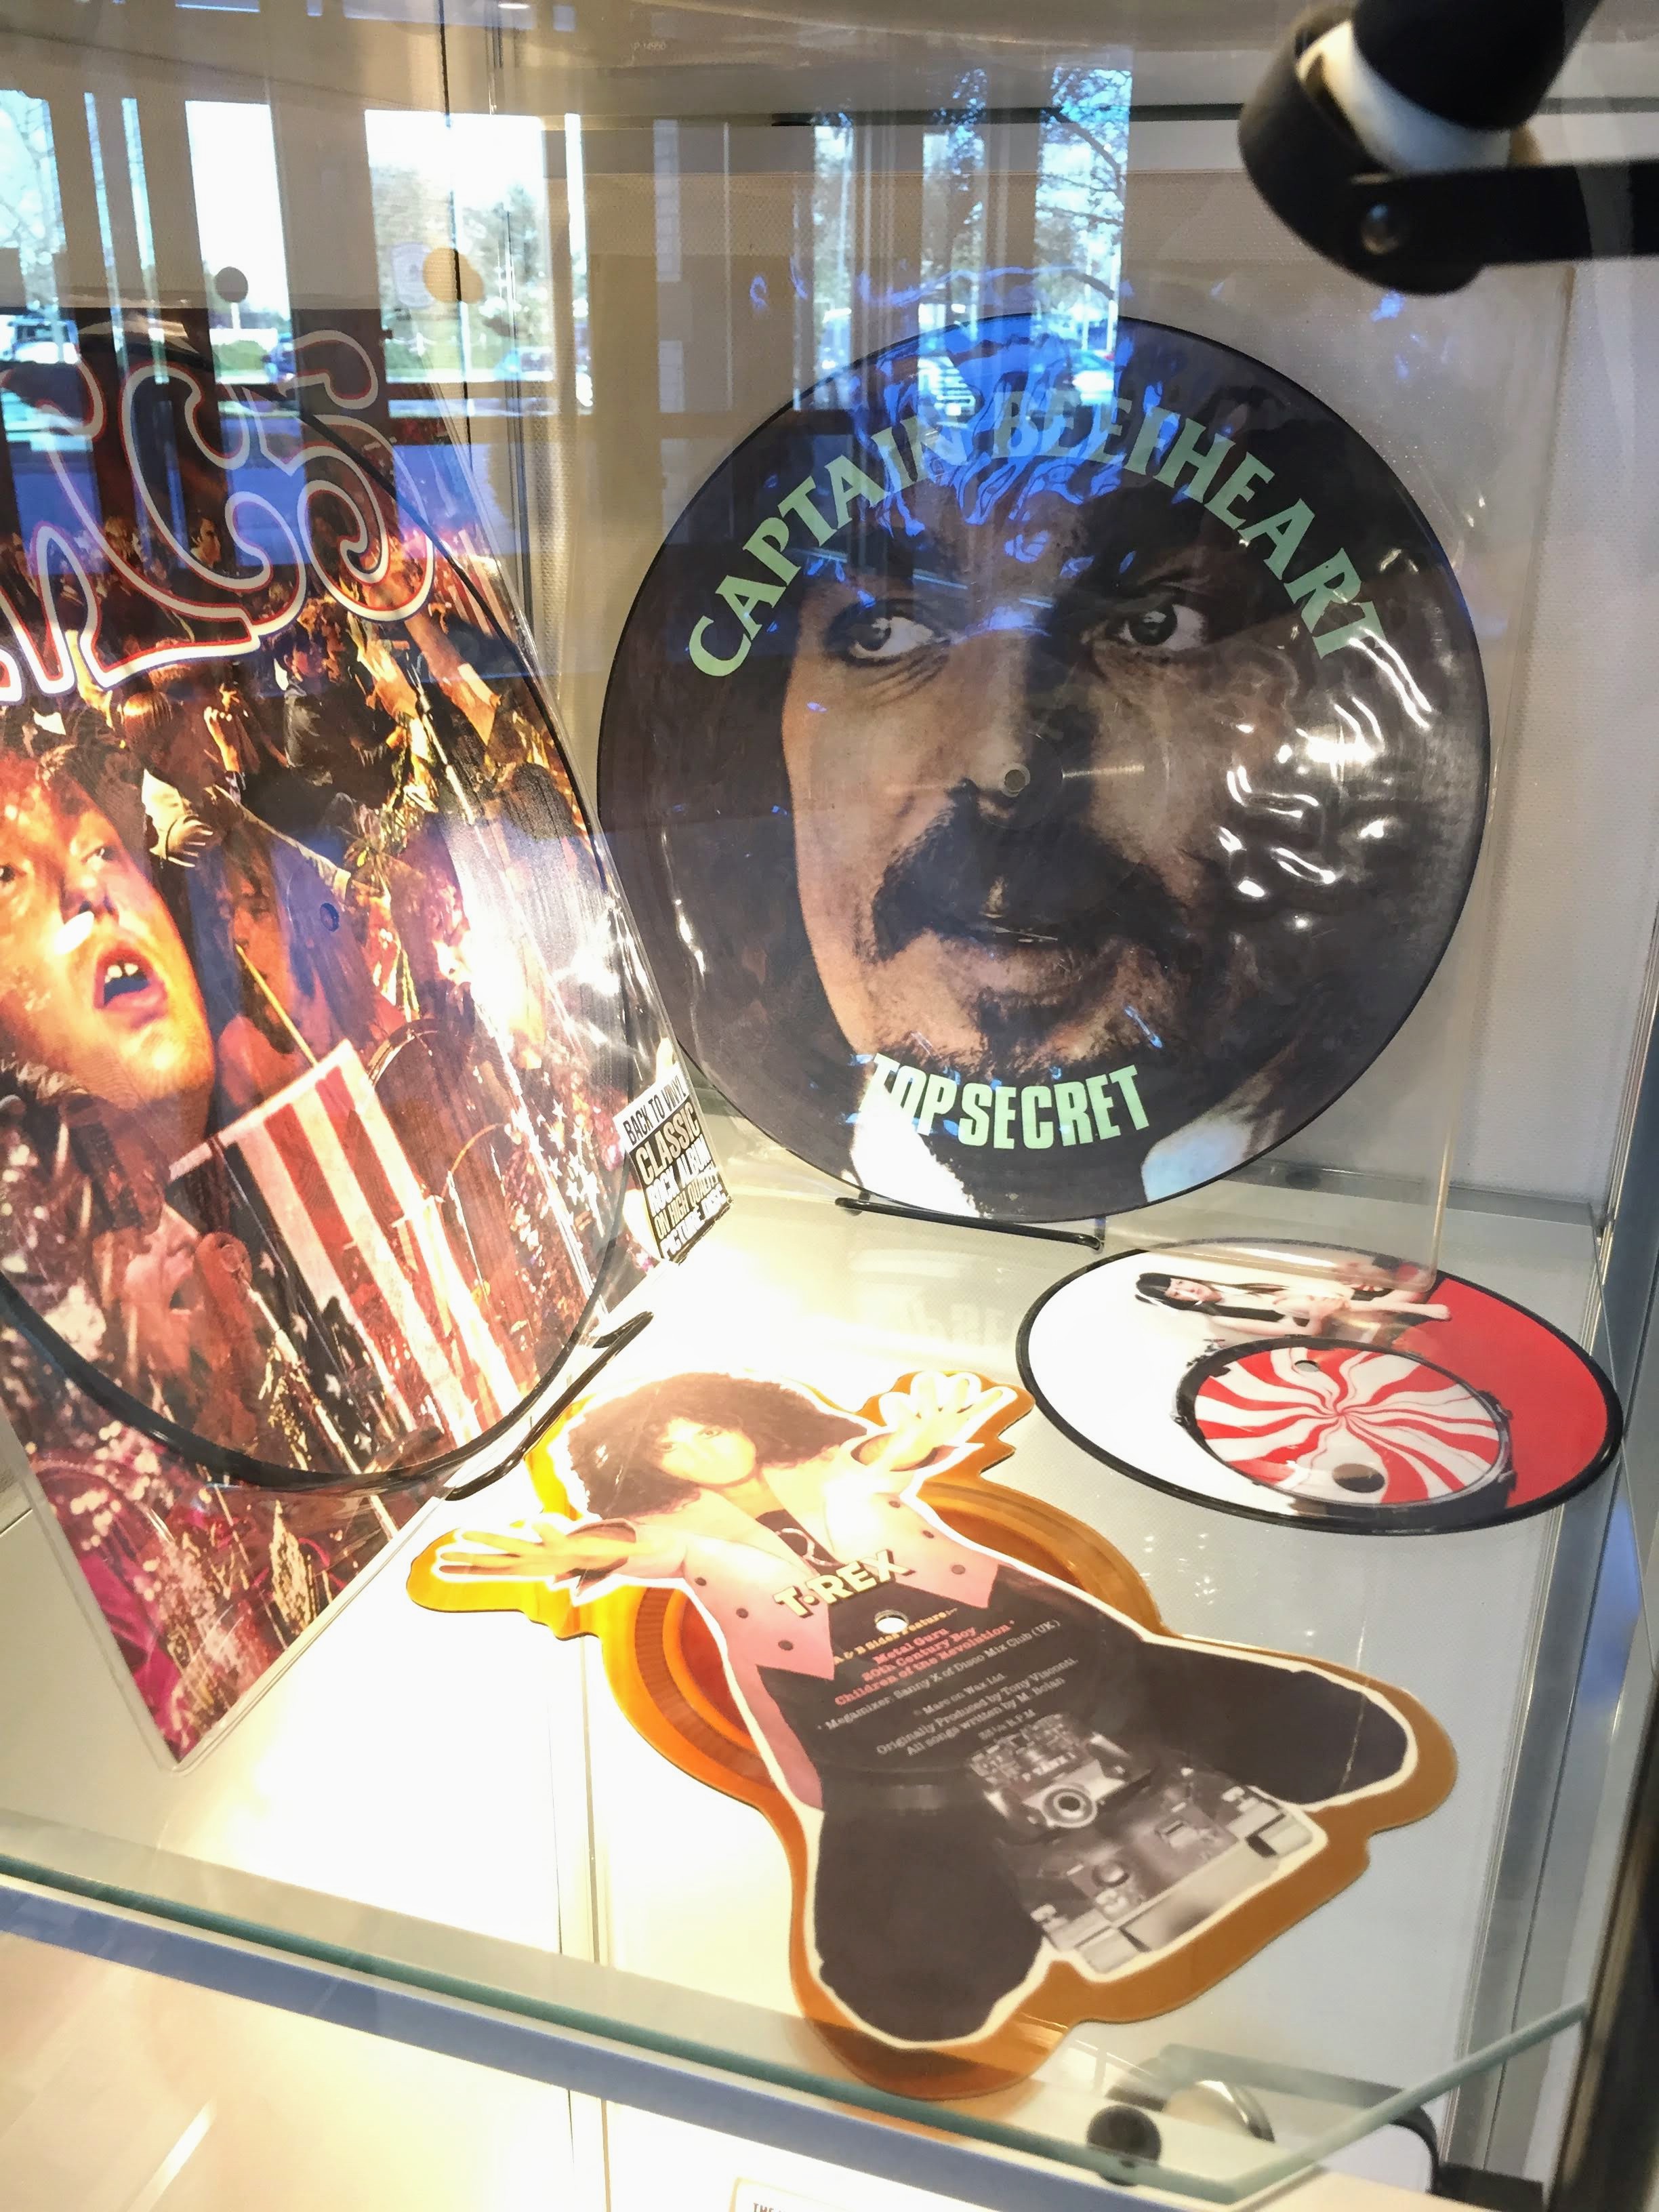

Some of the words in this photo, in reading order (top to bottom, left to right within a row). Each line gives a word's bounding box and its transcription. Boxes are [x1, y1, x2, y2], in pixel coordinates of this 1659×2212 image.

[623, 1106, 655, 1145] BACK
[648, 1094, 666, 1120] TO
[661, 1075, 687, 1113] VINYL
[957, 1065, 1150, 1149] SECRET
[635, 1101, 701, 1186] CLASSIC
[646, 1164, 681, 1213] ROCK
[654, 1210, 672, 1240] ON
[667, 1192, 691, 1229] HIGH
[865, 1632, 901, 1650] Sides
[872, 1642, 915, 1664] Metal
[913, 1628, 949, 1646] Guru
[896, 1639, 950, 1666] Century
[949, 1627, 977, 1643] Boy
[942, 1666, 956, 1678] of
[983, 1643, 1008, 1658] Mix
[1006, 1632, 1033, 1648] Club
[834, 1675, 899, 1706] Children
[898, 1665, 914, 1678] of
[913, 1658, 939, 1671] the
[876, 1723, 936, 1755] Originally
[985, 1692, 1003, 1704] by
[1000, 1679, 1031, 1696] Tony
[924, 1726, 960, 1748] songs
[1000, 1698, 1017, 1711] by
